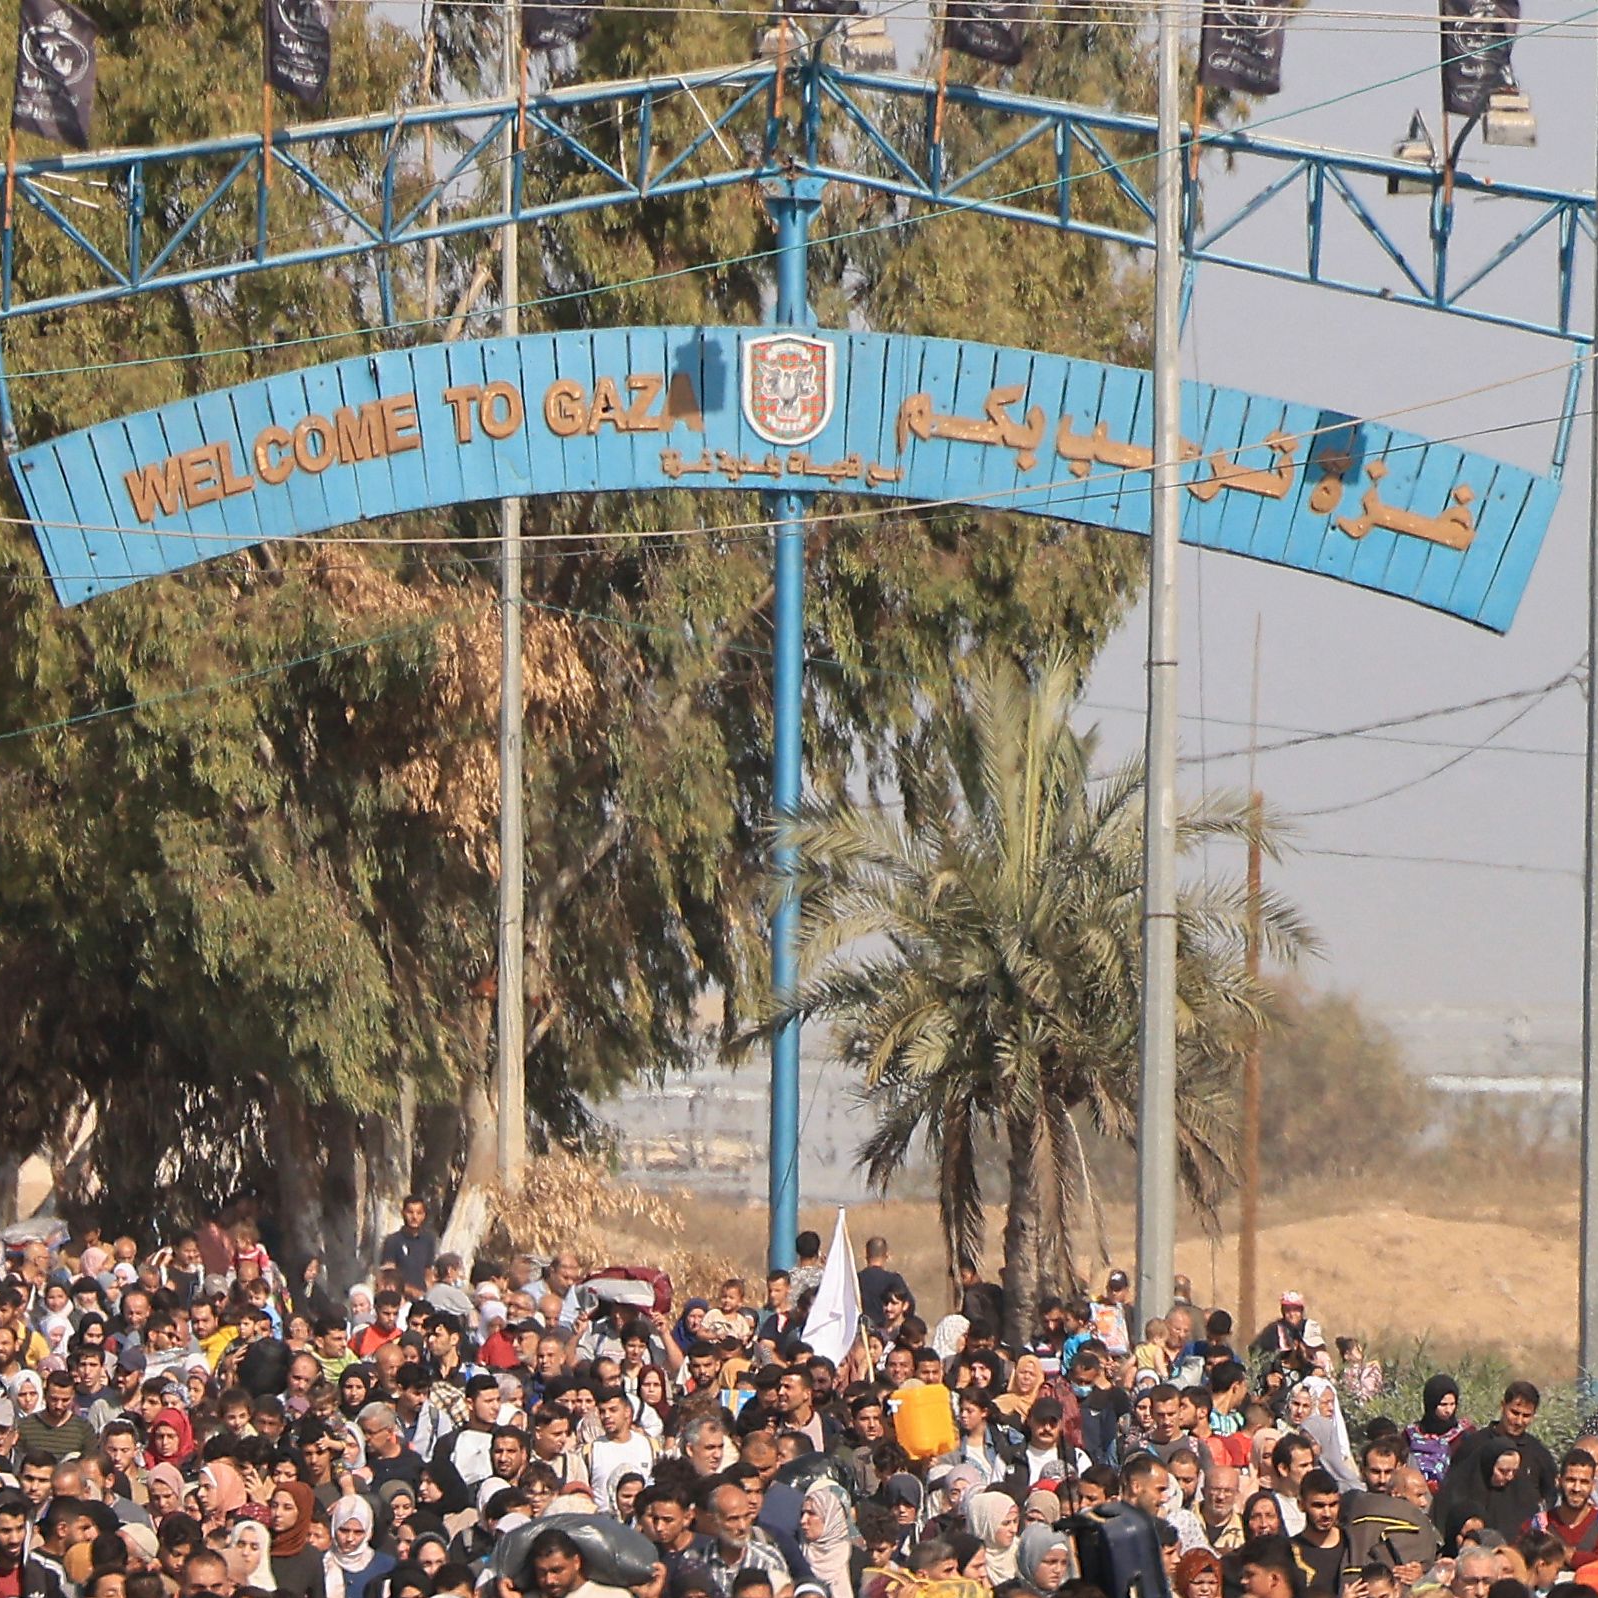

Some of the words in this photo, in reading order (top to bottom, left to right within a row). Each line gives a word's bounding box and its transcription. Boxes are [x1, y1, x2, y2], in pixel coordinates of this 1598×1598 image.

[124, 393, 422, 523] WELCOME
[443, 381, 524, 443] TO
[544, 373, 704, 436] GAZA
[894, 384, 1046, 472] بكم
[1309, 448, 1476, 551] غزة
